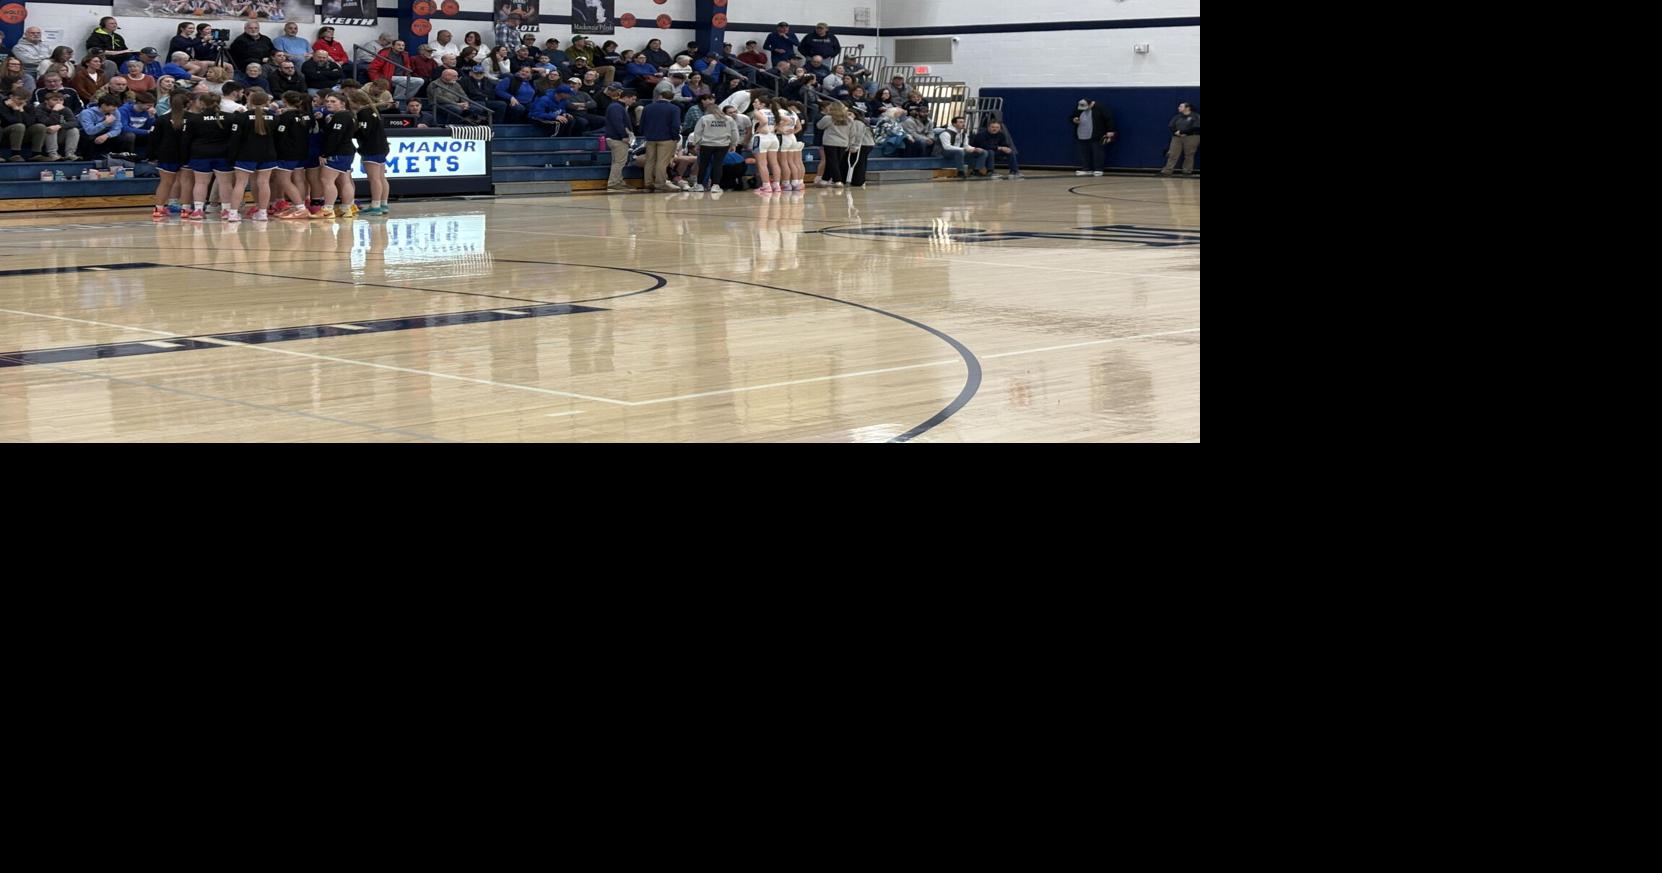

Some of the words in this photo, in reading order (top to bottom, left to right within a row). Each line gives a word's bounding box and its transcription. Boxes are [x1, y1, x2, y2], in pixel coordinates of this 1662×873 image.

[323, 17, 375, 26] KEITH
[398, 141, 476, 153] MANOR
[350, 155, 460, 174] METS
